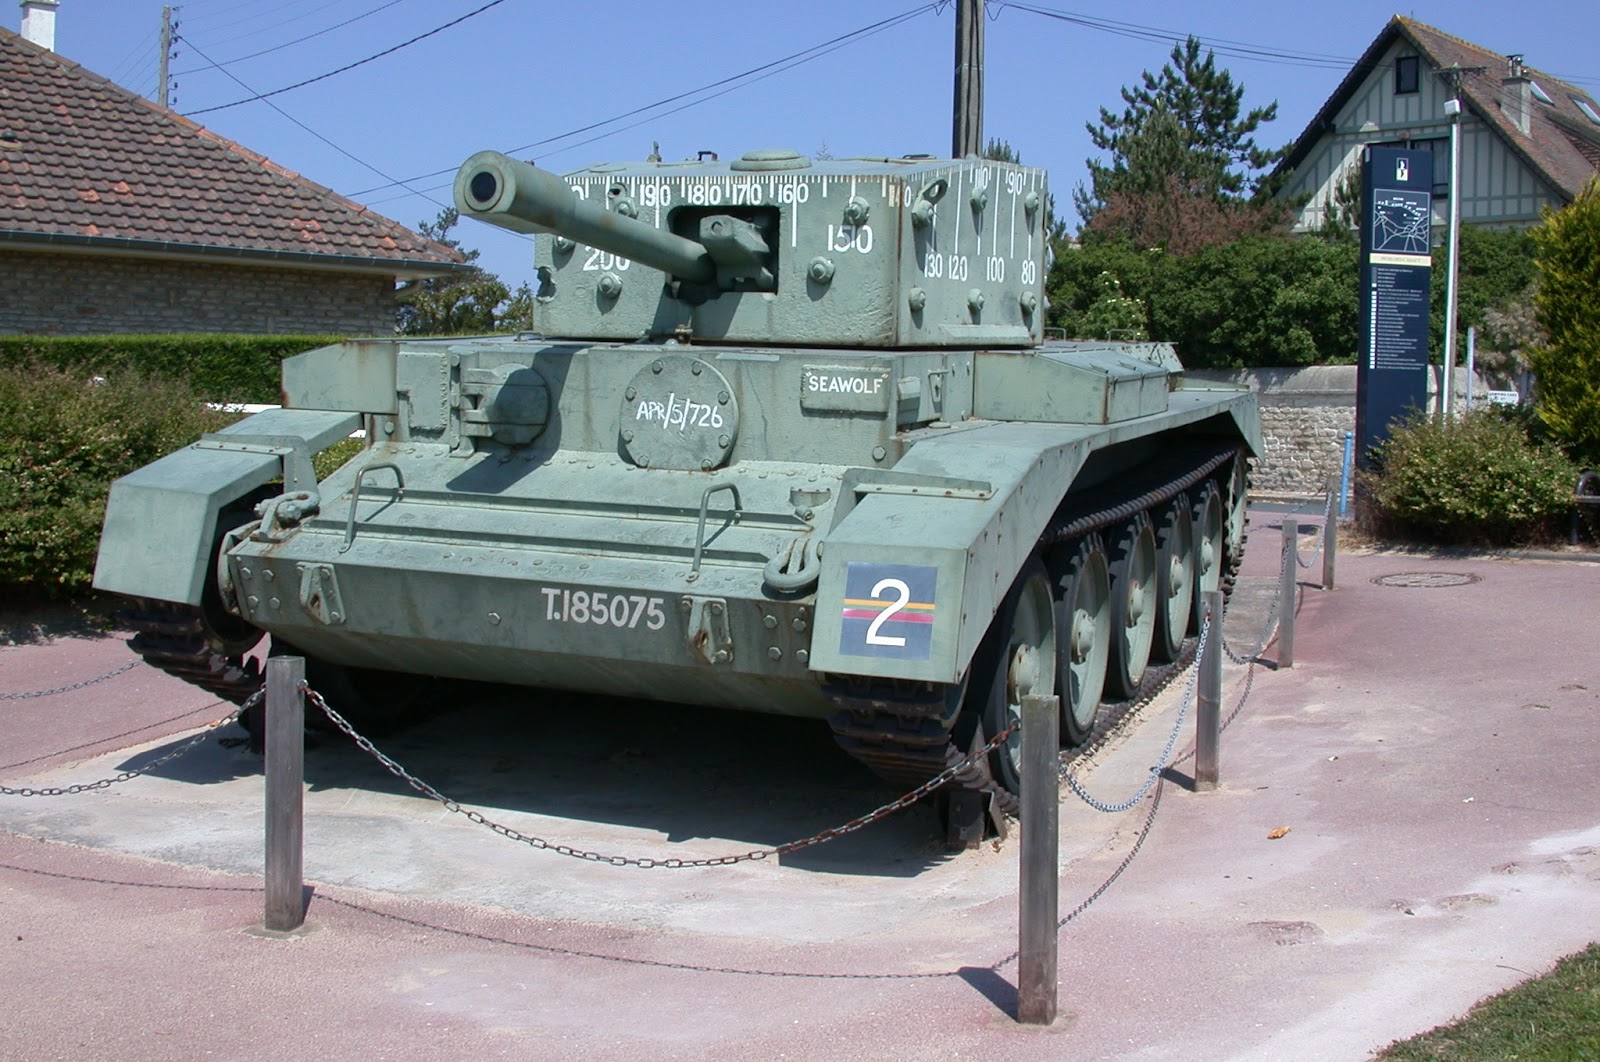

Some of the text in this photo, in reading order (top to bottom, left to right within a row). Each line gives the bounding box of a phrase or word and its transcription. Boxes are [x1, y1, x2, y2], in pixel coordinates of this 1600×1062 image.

[640, 184, 671, 207] 190
[688, 184, 721, 206] 180
[732, 183, 762, 206] 170
[778, 182, 809, 204] 160
[1007, 171, 1023, 196] 90
[827, 224, 873, 254] 150
[924, 253, 1036, 285] 130 120 100 80
[636, 392, 723, 431] APR/5/726
[865, 578, 910, 647] 2
